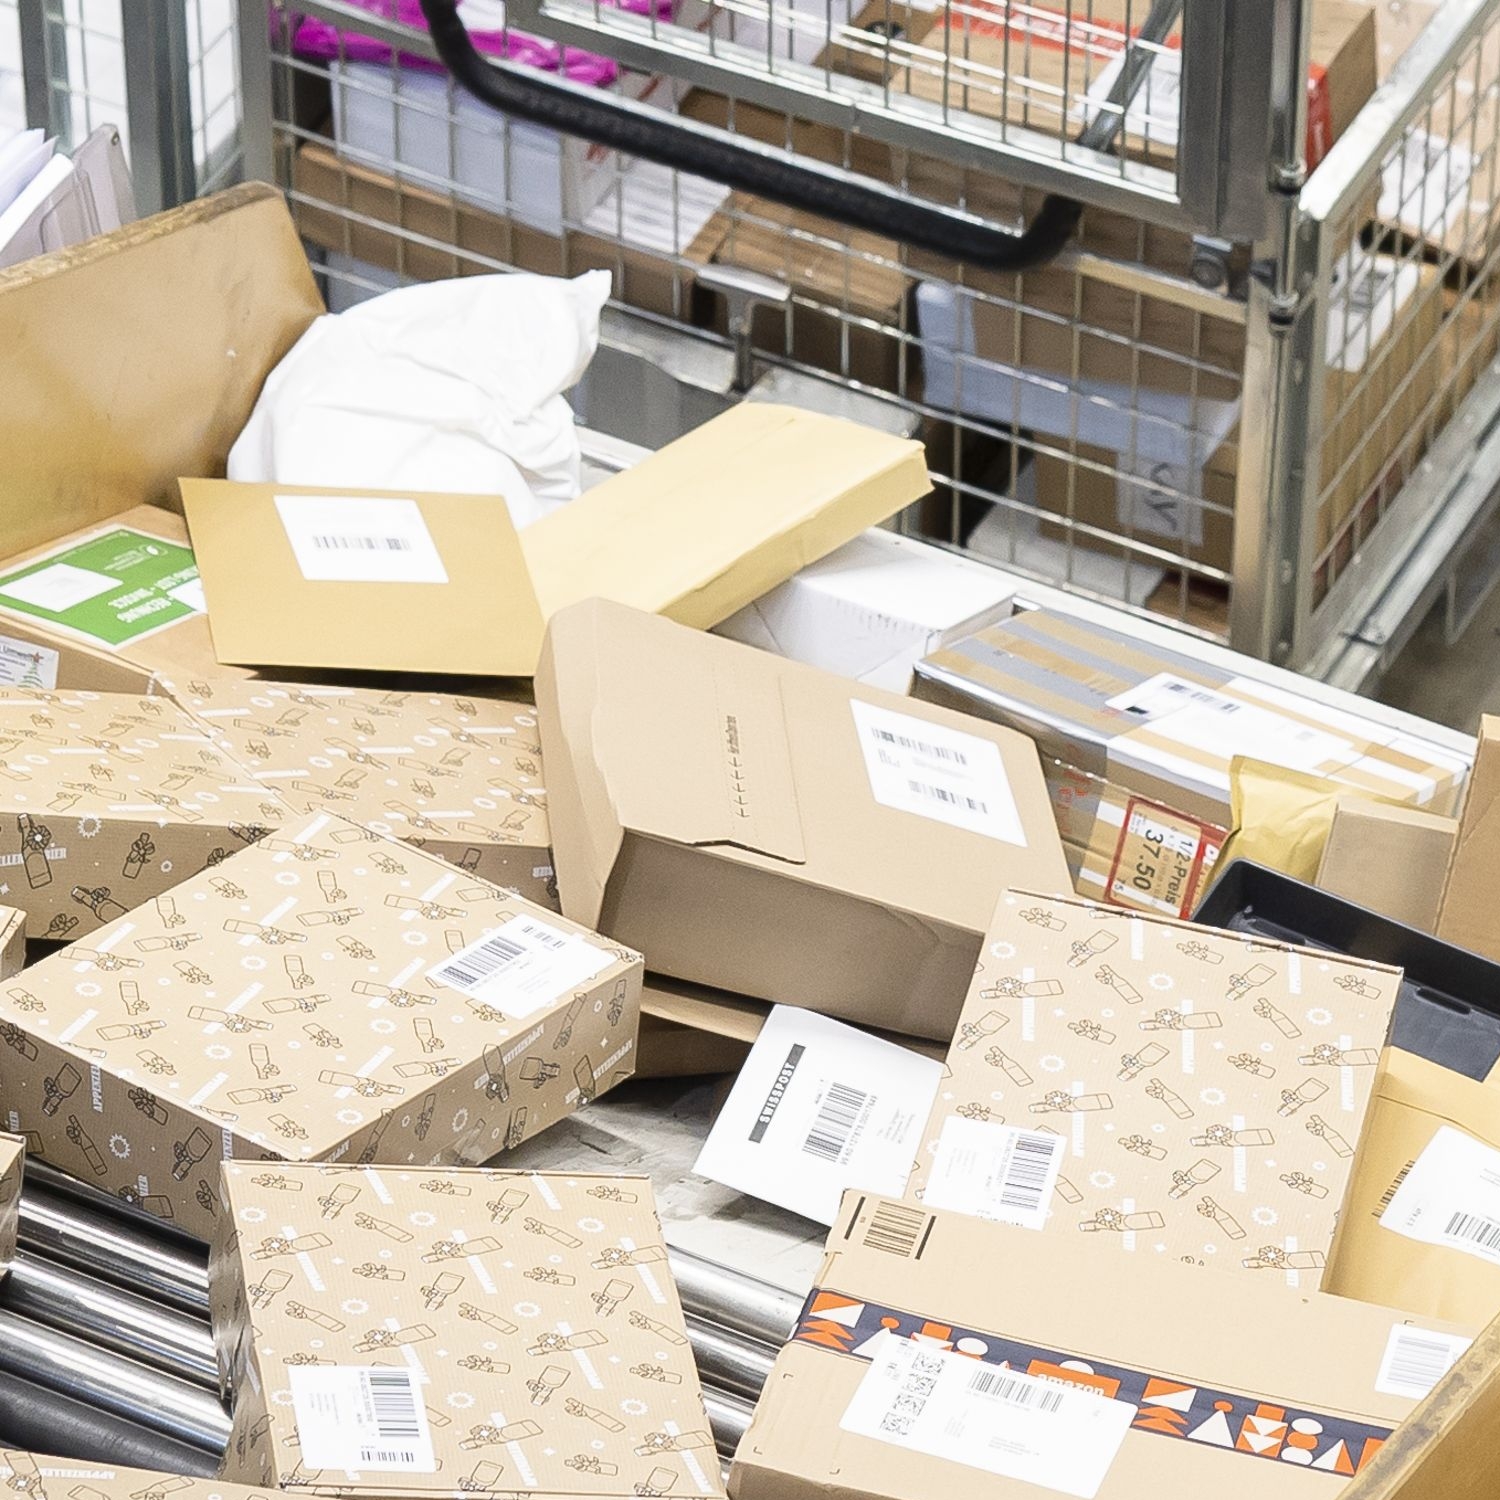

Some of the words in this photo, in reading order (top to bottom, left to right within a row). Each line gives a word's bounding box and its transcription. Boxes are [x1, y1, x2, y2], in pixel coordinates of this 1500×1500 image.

[1132, 828, 1166, 892] 37.50
[1164, 837, 1195, 906] 1/2-Preis
[759, 1061, 796, 1125] SWISSPOST
[1036, 1371, 1107, 1399] amazon
